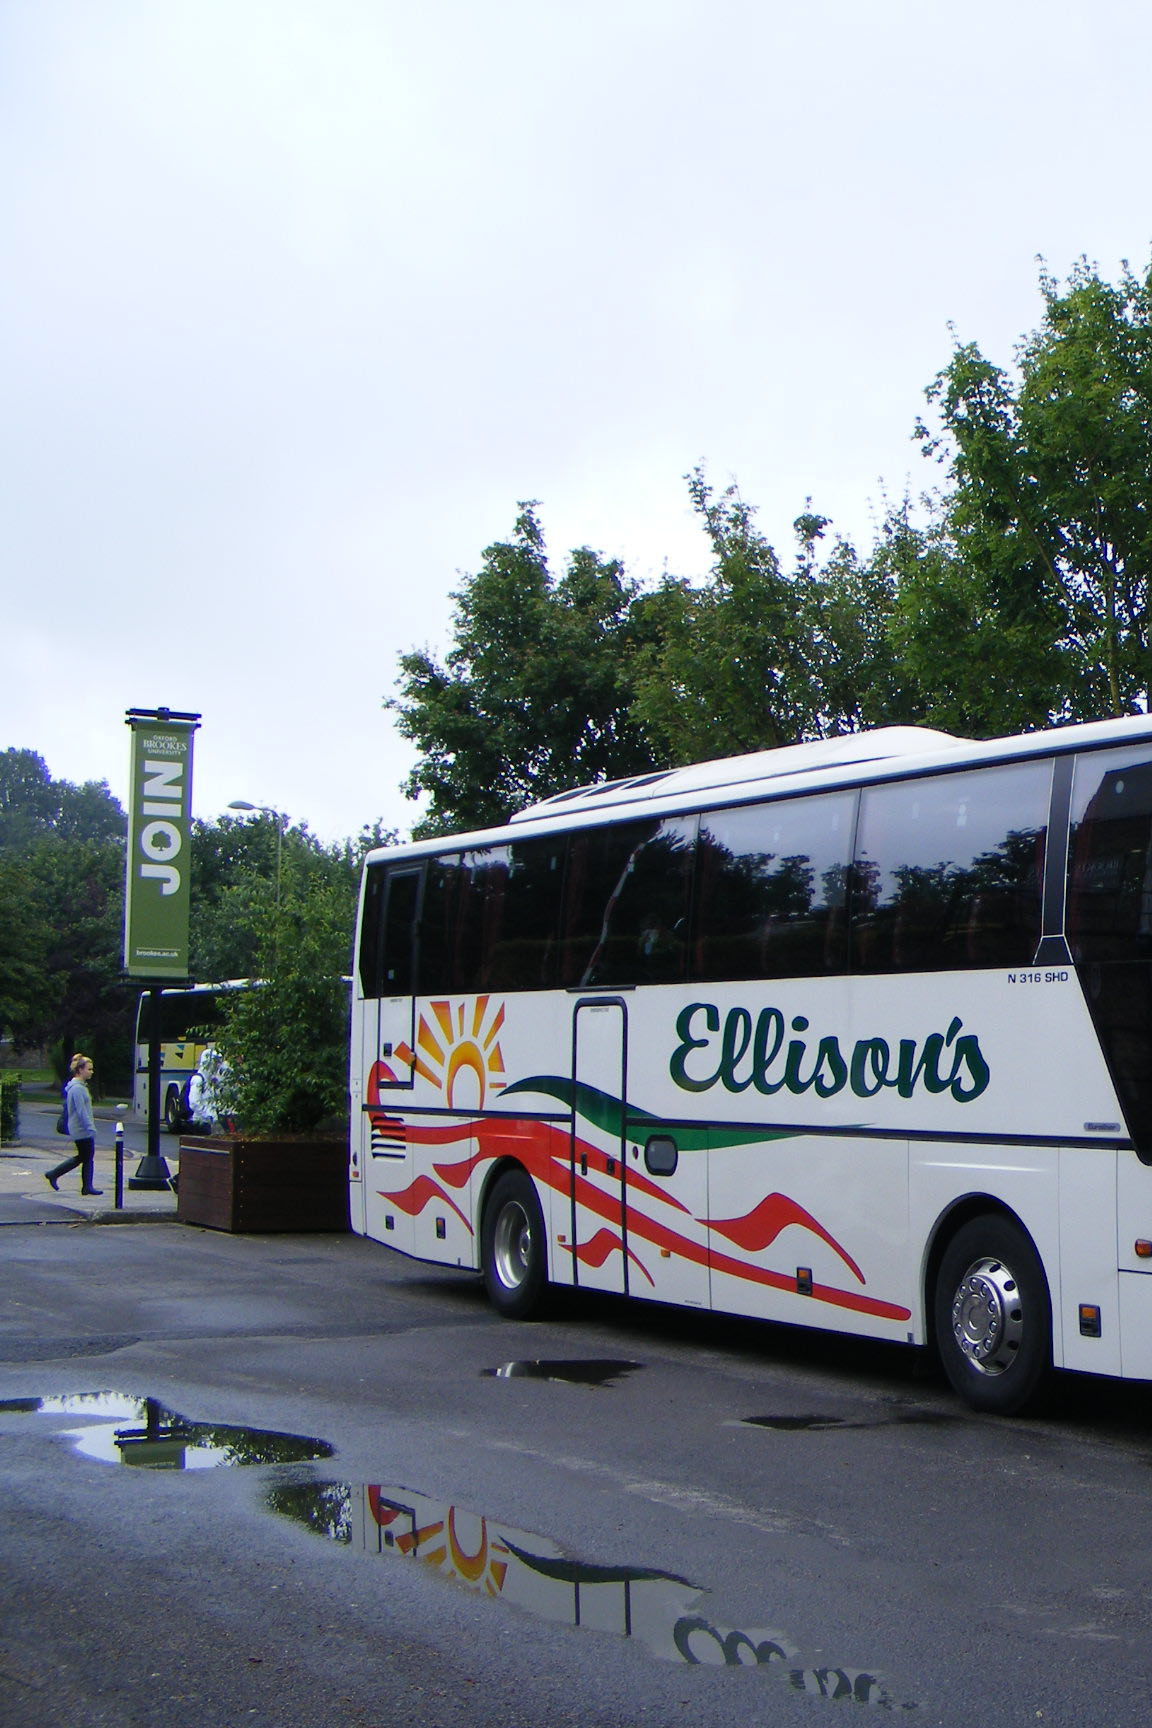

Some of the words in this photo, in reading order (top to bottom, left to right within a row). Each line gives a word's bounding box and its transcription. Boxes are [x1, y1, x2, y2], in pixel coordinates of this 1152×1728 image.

[152, 734, 178, 742] OXFORD
[143, 739, 188, 752] BROOKES
[147, 748, 182, 756] UNIVERSITY
[140, 759, 184, 896] JOIN
[1007, 973, 1017, 984] N
[1019, 972, 1042, 984] 316
[1044, 971, 1069, 983] SHD
[669, 1002, 991, 1103] Ellison's
